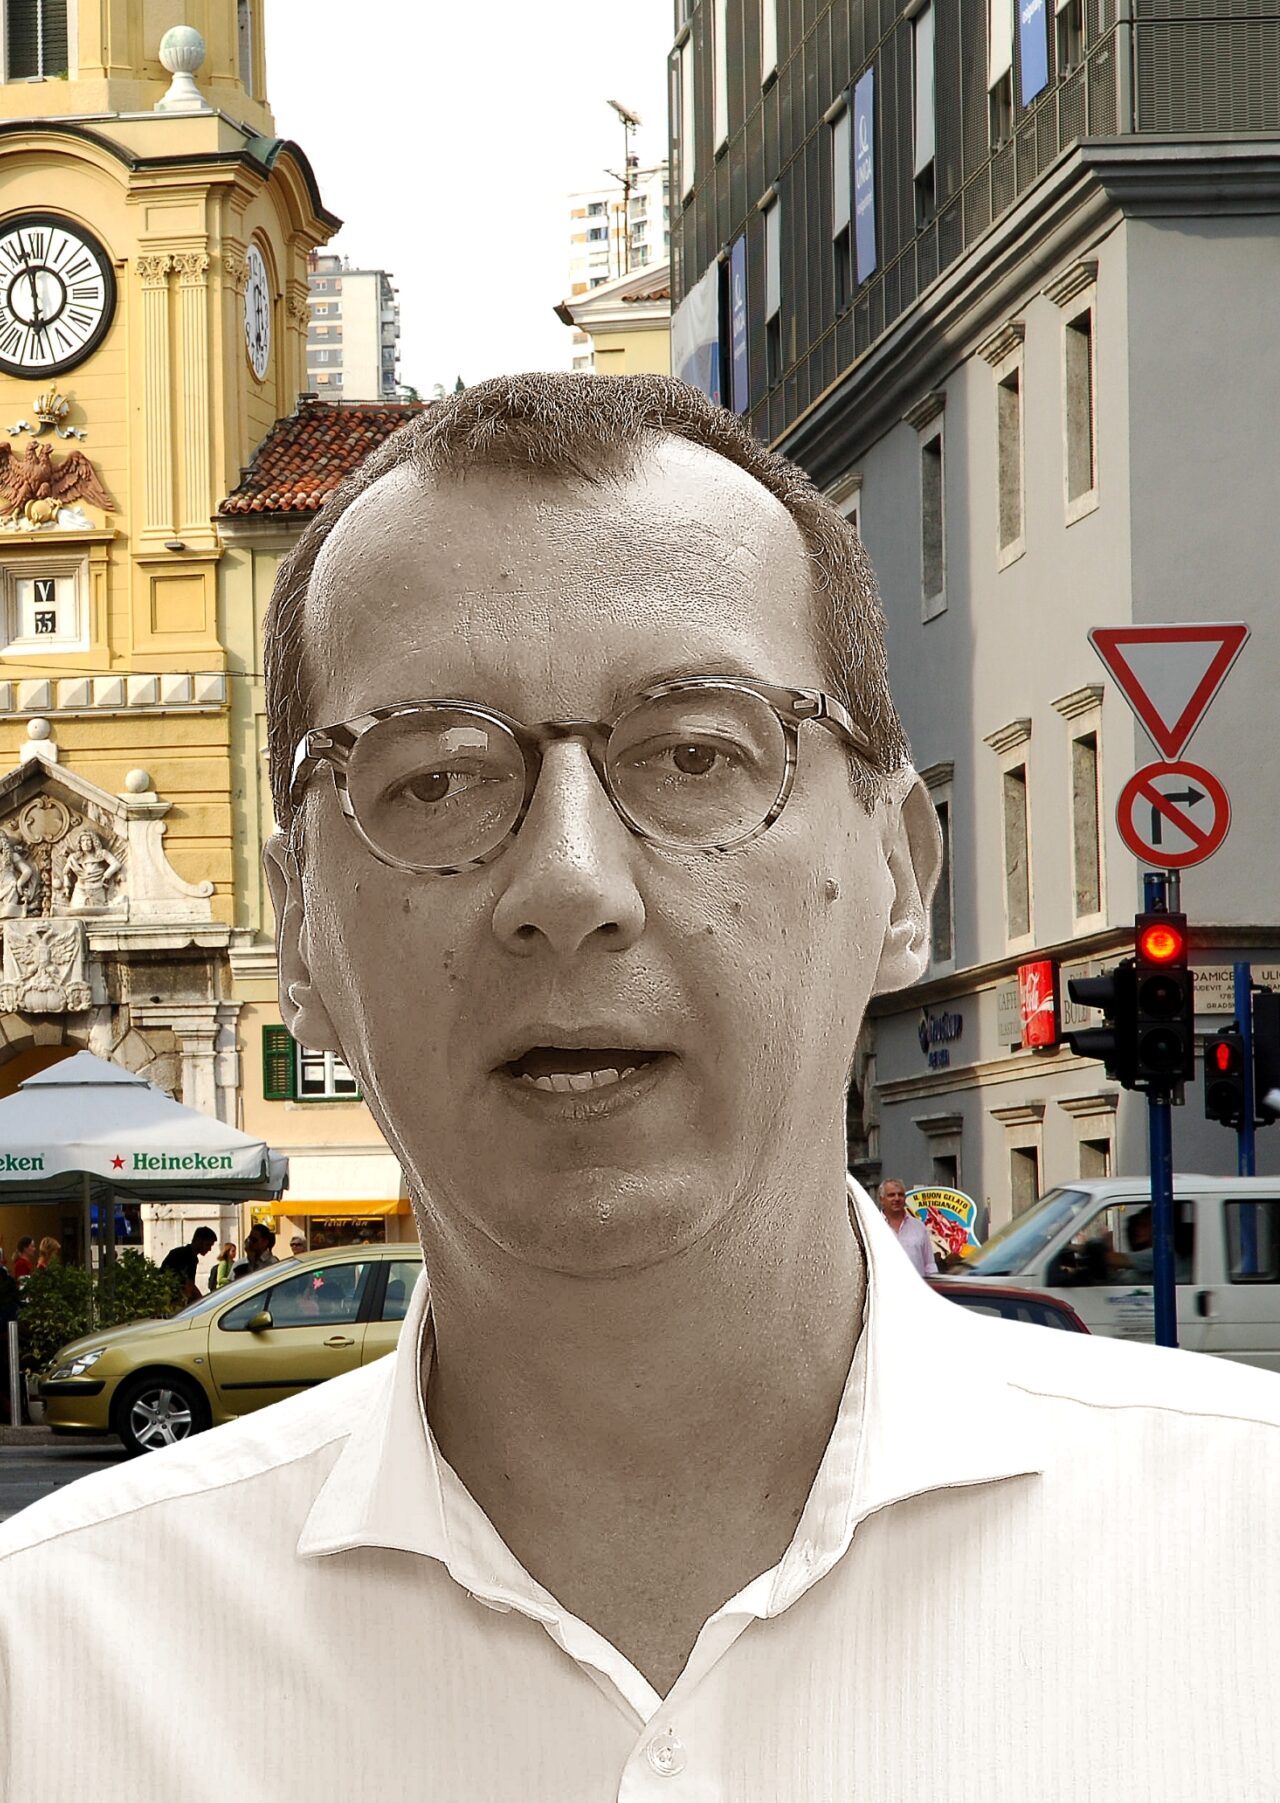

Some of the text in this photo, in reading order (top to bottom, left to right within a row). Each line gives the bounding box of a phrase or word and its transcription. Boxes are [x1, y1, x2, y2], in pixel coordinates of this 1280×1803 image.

[27, 233, 44, 260] XII
[53, 238, 69, 264] I
[65, 257, 92, 279] II
[72, 286, 99, 300] III
[67, 309, 94, 333] IV
[0, 327, 23, 358] VII
[55, 327, 73, 353] V
[35, 581, 52, 602] V
[35, 613, 52, 633] 55
[132, 1153, 232, 1170] Heineken
[918, 1200, 962, 1214] ARTIGIANALE
[943, 1193, 968, 1209] GELATO
